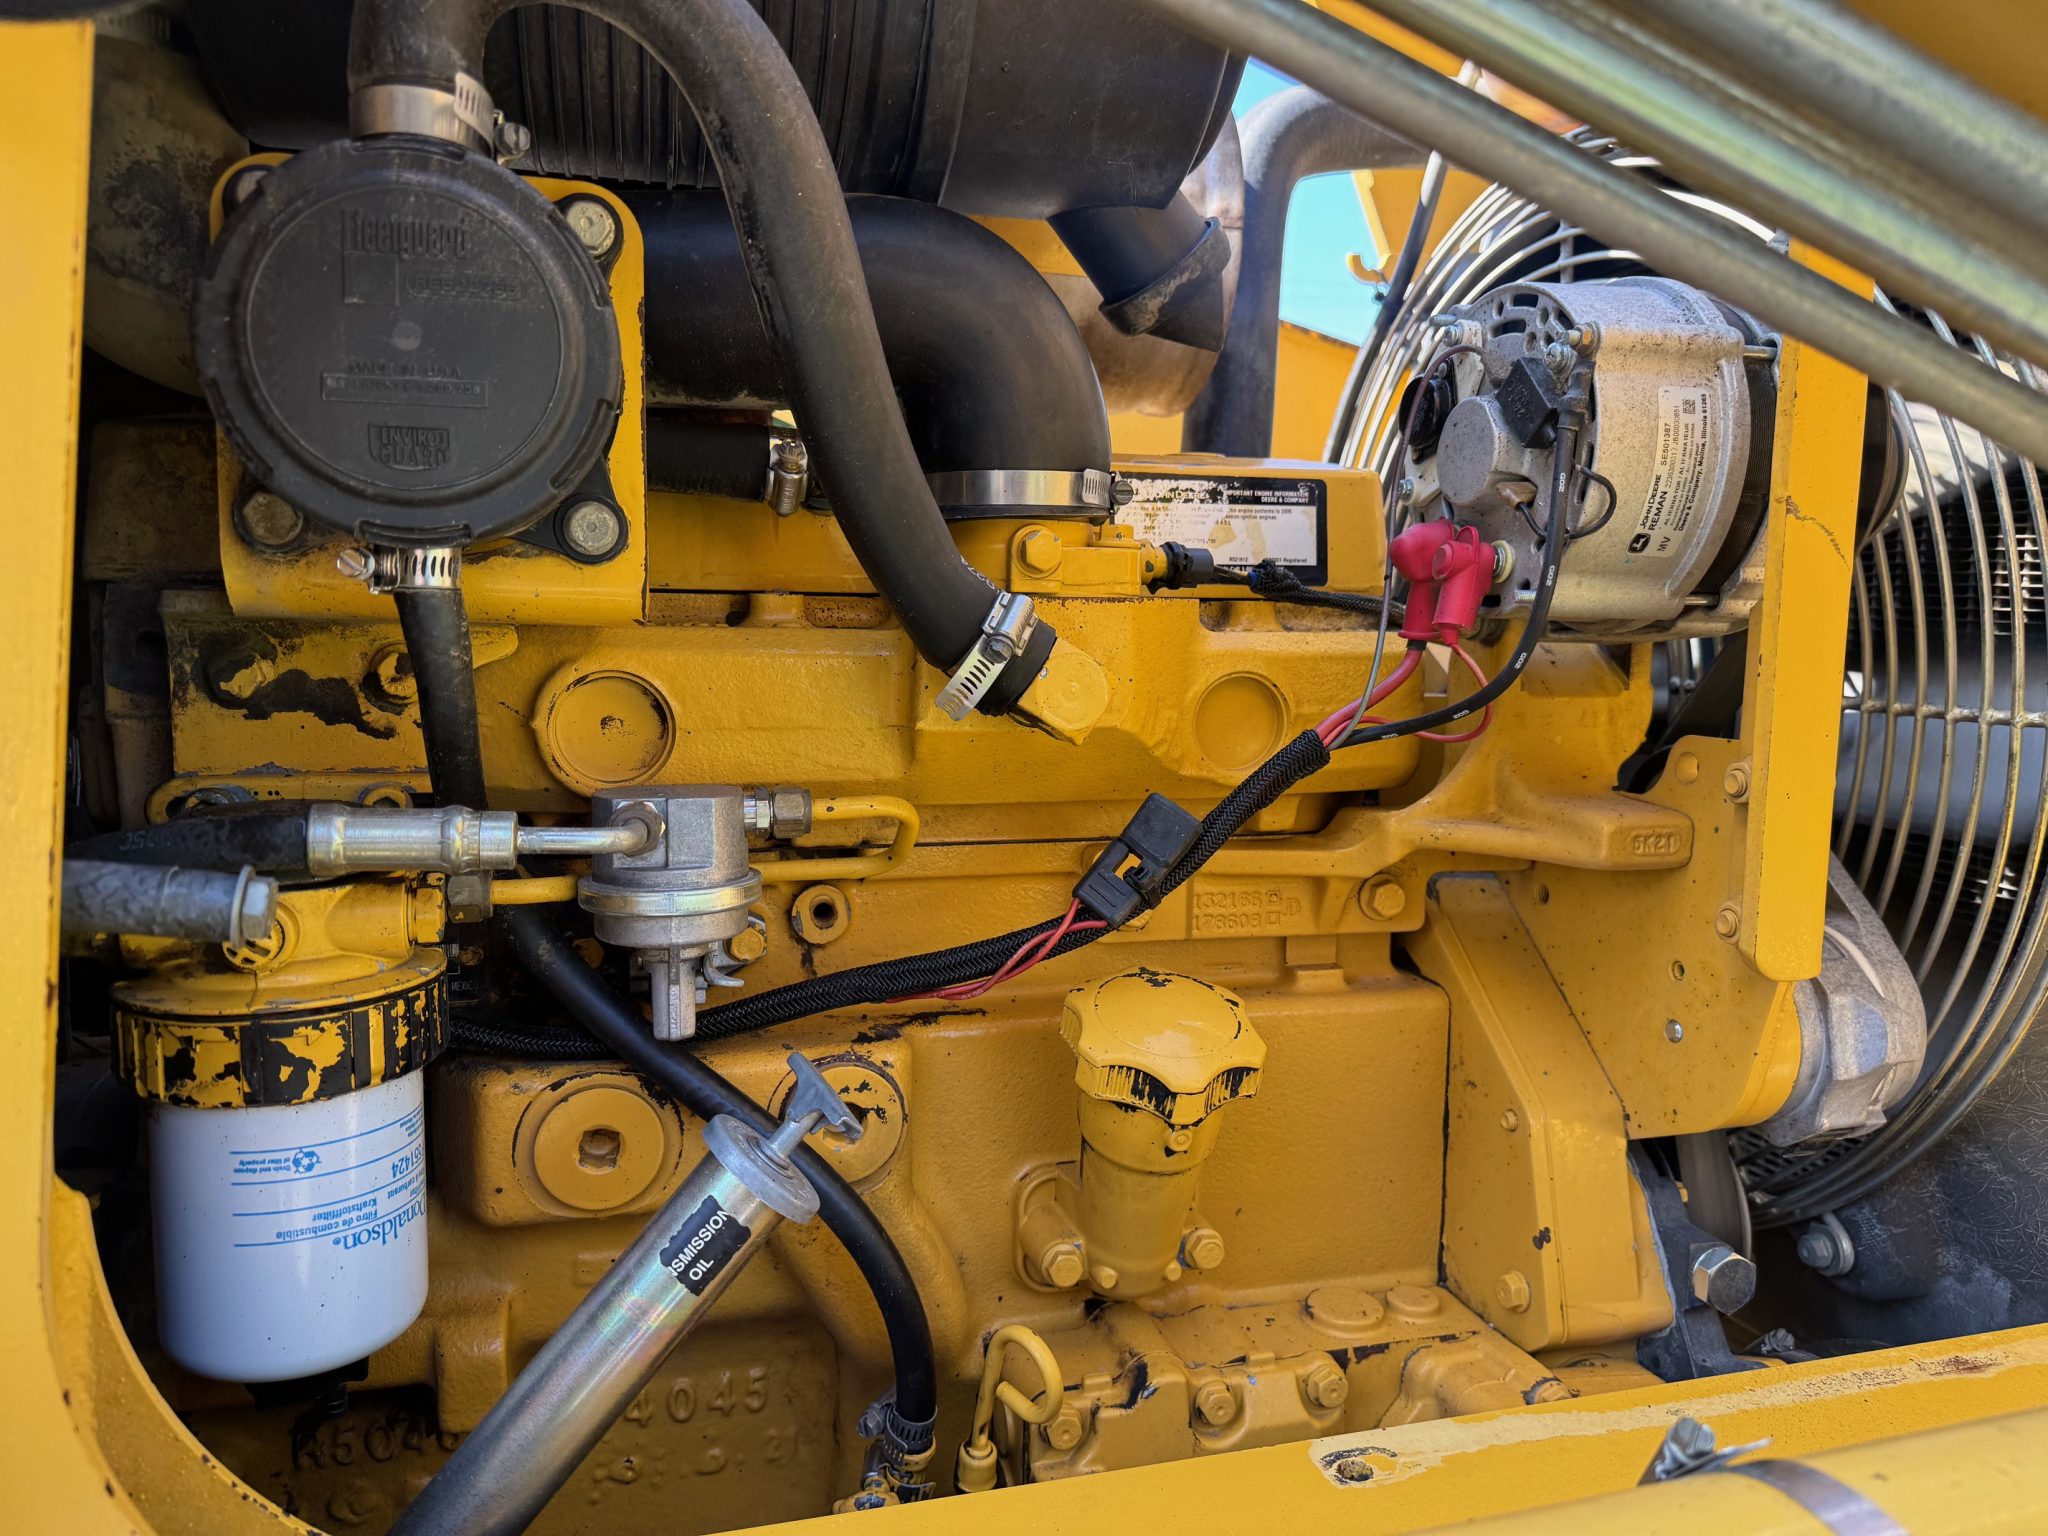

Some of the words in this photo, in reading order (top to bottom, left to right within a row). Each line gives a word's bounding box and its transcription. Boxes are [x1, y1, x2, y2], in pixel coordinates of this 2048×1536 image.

[380, 427, 440, 446] ENVIRO
[1661, 423, 1671, 466] SE501387
[379, 446, 449, 466] GUARD
[1274, 490, 1309, 498] INFORMATION
[1678, 512, 1690, 530] Deere
[1689, 469, 1703, 504] Company,
[1698, 441, 1707, 467] Moline,
[1640, 506, 1653, 529] JOHN
[1648, 474, 1661, 504] DEERE
[1648, 491, 1668, 530] REMAN
[1657, 537, 1670, 552] MV
[387, 1177, 415, 1199] carburant
[342, 1217, 354, 1227] de
[357, 1209, 378, 1223] Filtro
[276, 1220, 339, 1240] combustible
[689, 1260, 714, 1281] OIL
